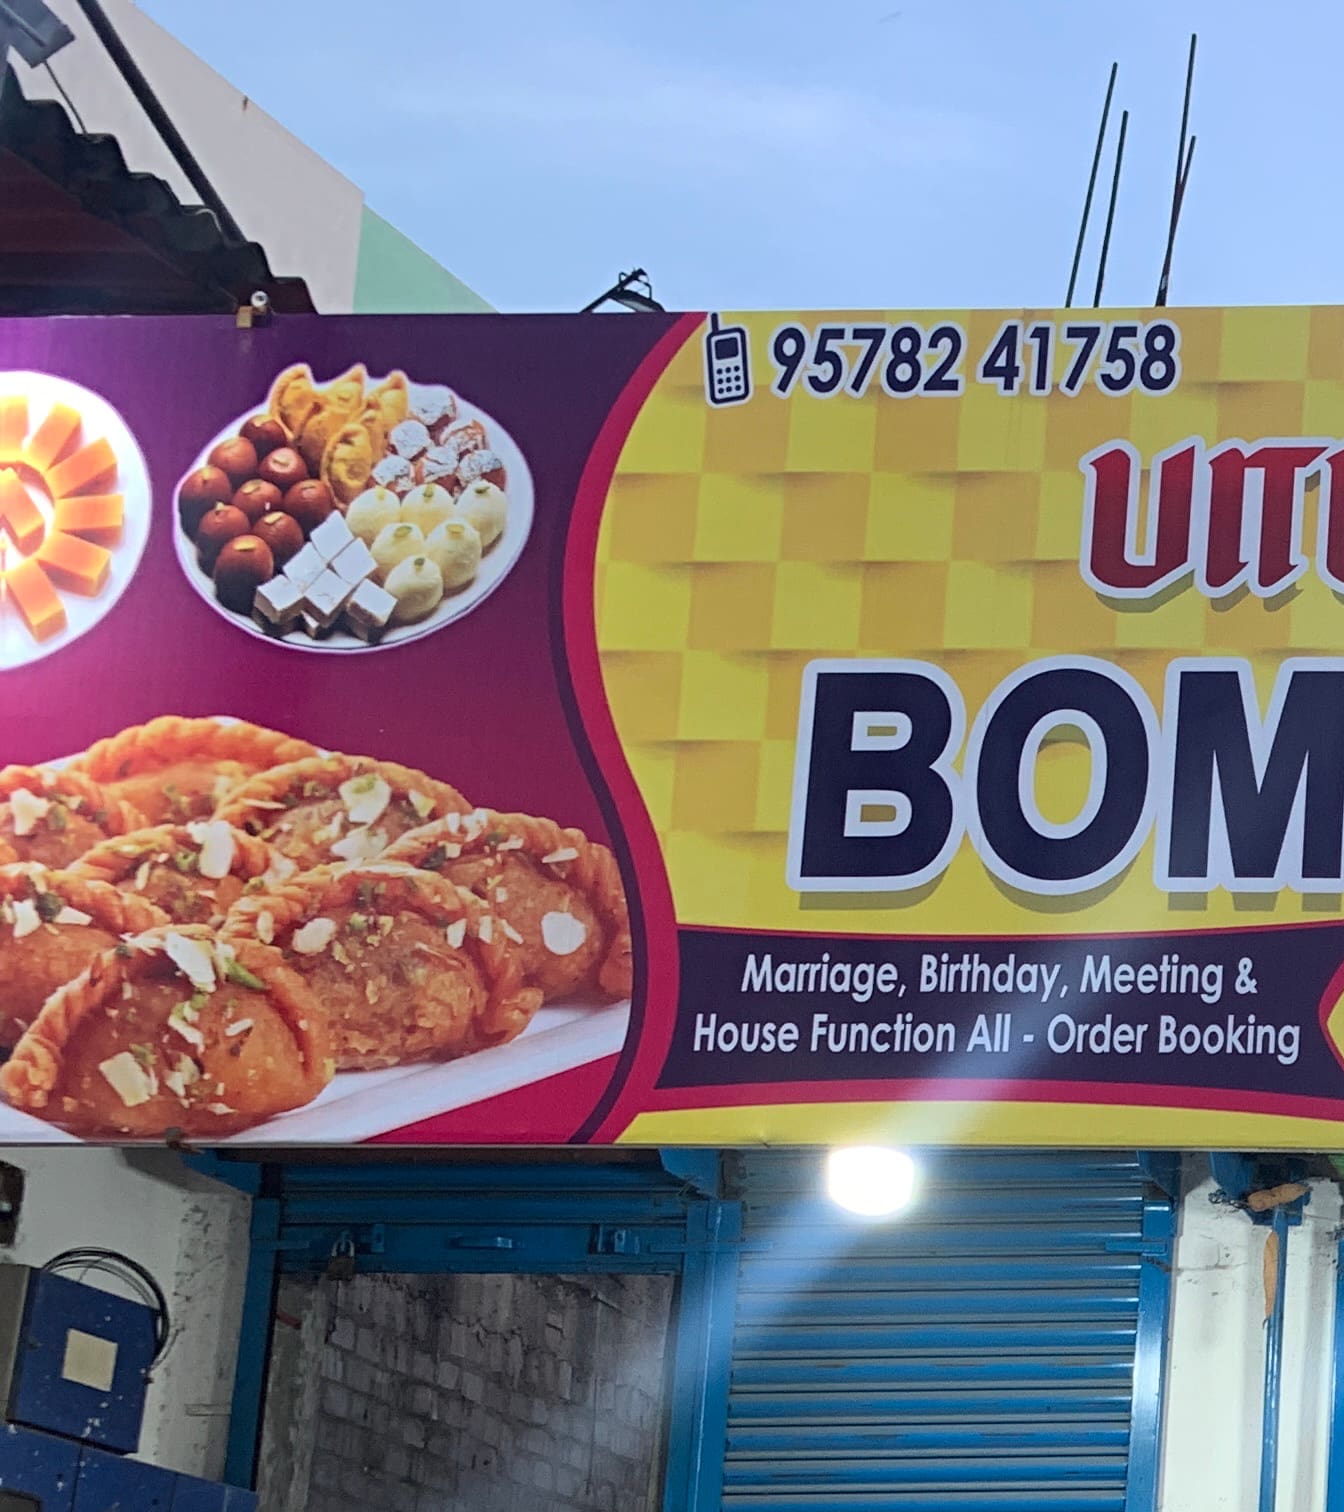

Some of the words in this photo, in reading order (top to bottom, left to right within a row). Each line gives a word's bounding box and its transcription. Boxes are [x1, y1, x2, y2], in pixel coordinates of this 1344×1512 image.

[770, 325, 962, 393] 95782
[983, 323, 1178, 392] 41758
[741, 953, 906, 1001] Marriage,
[920, 953, 1067, 1002] Birthday,
[1080, 954, 1221, 1003] Meeting
[1235, 956, 1257, 995] &
[693, 1013, 799, 1053] House
[810, 1013, 954, 1053] Function
[967, 1013, 1010, 1053] All
[1047, 1014, 1151, 1054] Order
[1159, 1014, 1300, 1065] Booking
